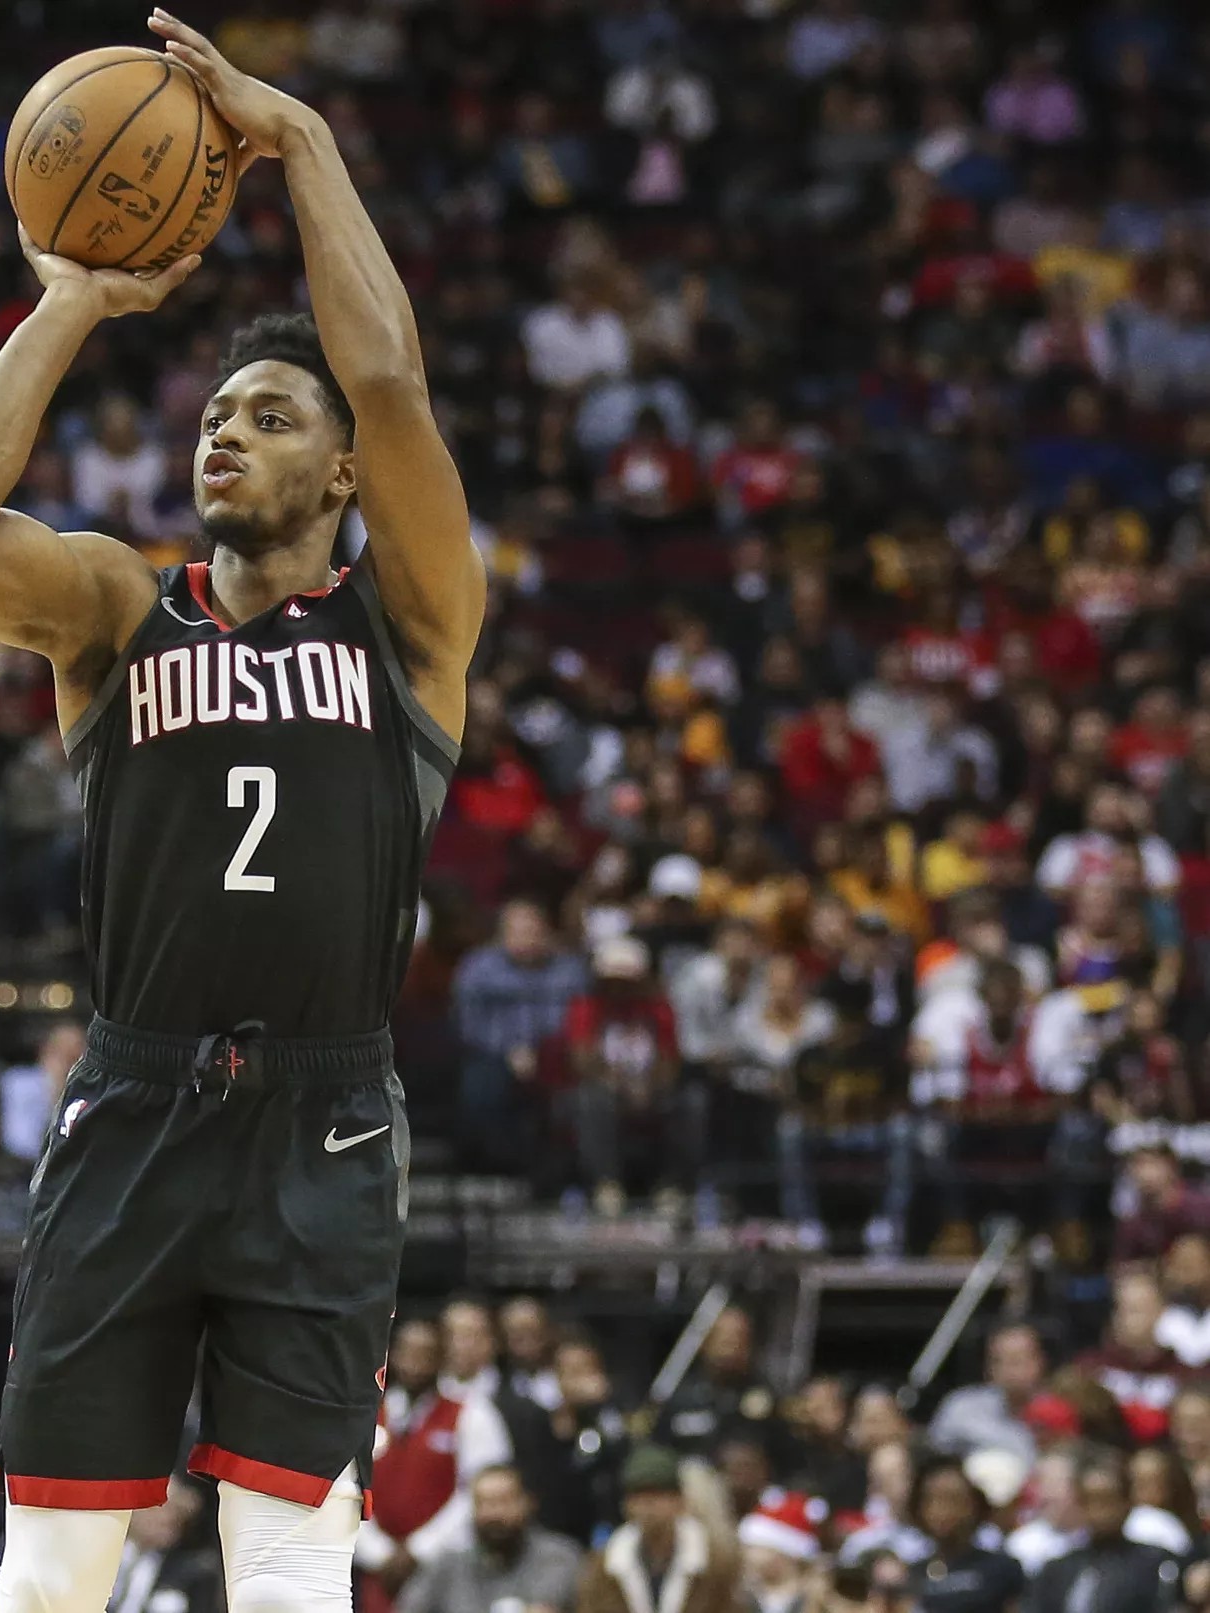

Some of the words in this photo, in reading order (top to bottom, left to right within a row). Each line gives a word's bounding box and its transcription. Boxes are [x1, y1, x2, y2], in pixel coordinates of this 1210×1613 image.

[147, 144, 228, 269] SPALDIN
[128, 640, 374, 747] HOUSTON
[223, 765, 277, 893] 2
